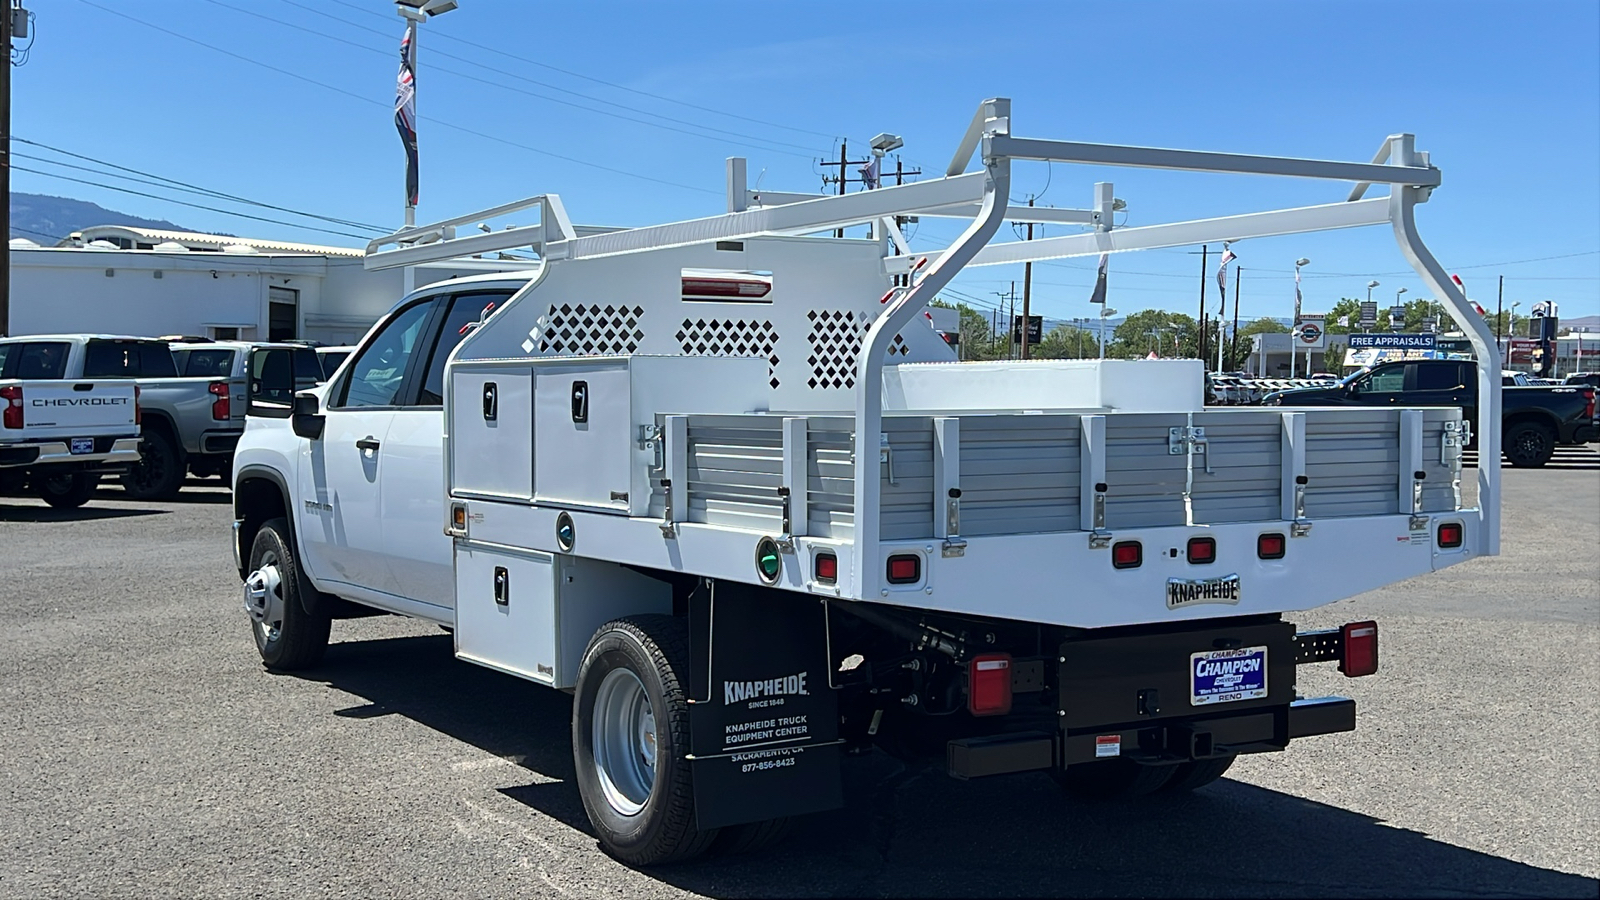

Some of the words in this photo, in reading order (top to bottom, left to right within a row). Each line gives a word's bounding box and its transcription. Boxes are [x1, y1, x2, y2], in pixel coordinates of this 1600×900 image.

[1351, 337, 1373, 346] FREE
[1374, 337, 1434, 346] APPRAISALS!
[32, 398, 129, 407] CHEVROLET
[1171, 579, 1238, 605] KNAPHEIDE
[1211, 649, 1248, 659] CHAMPION
[1196, 658, 1261, 677] CHAMPION
[1218, 693, 1242, 702] RENO
[748, 700, 768, 709] SINCE
[725, 719, 776, 734] KNAPHEIDE
[778, 715, 807, 726] TRUCK
[725, 730, 774, 744] EQUIPMENT
[775, 725, 808, 737] CENTER
[742, 758, 796, 773] 877-856-8423
